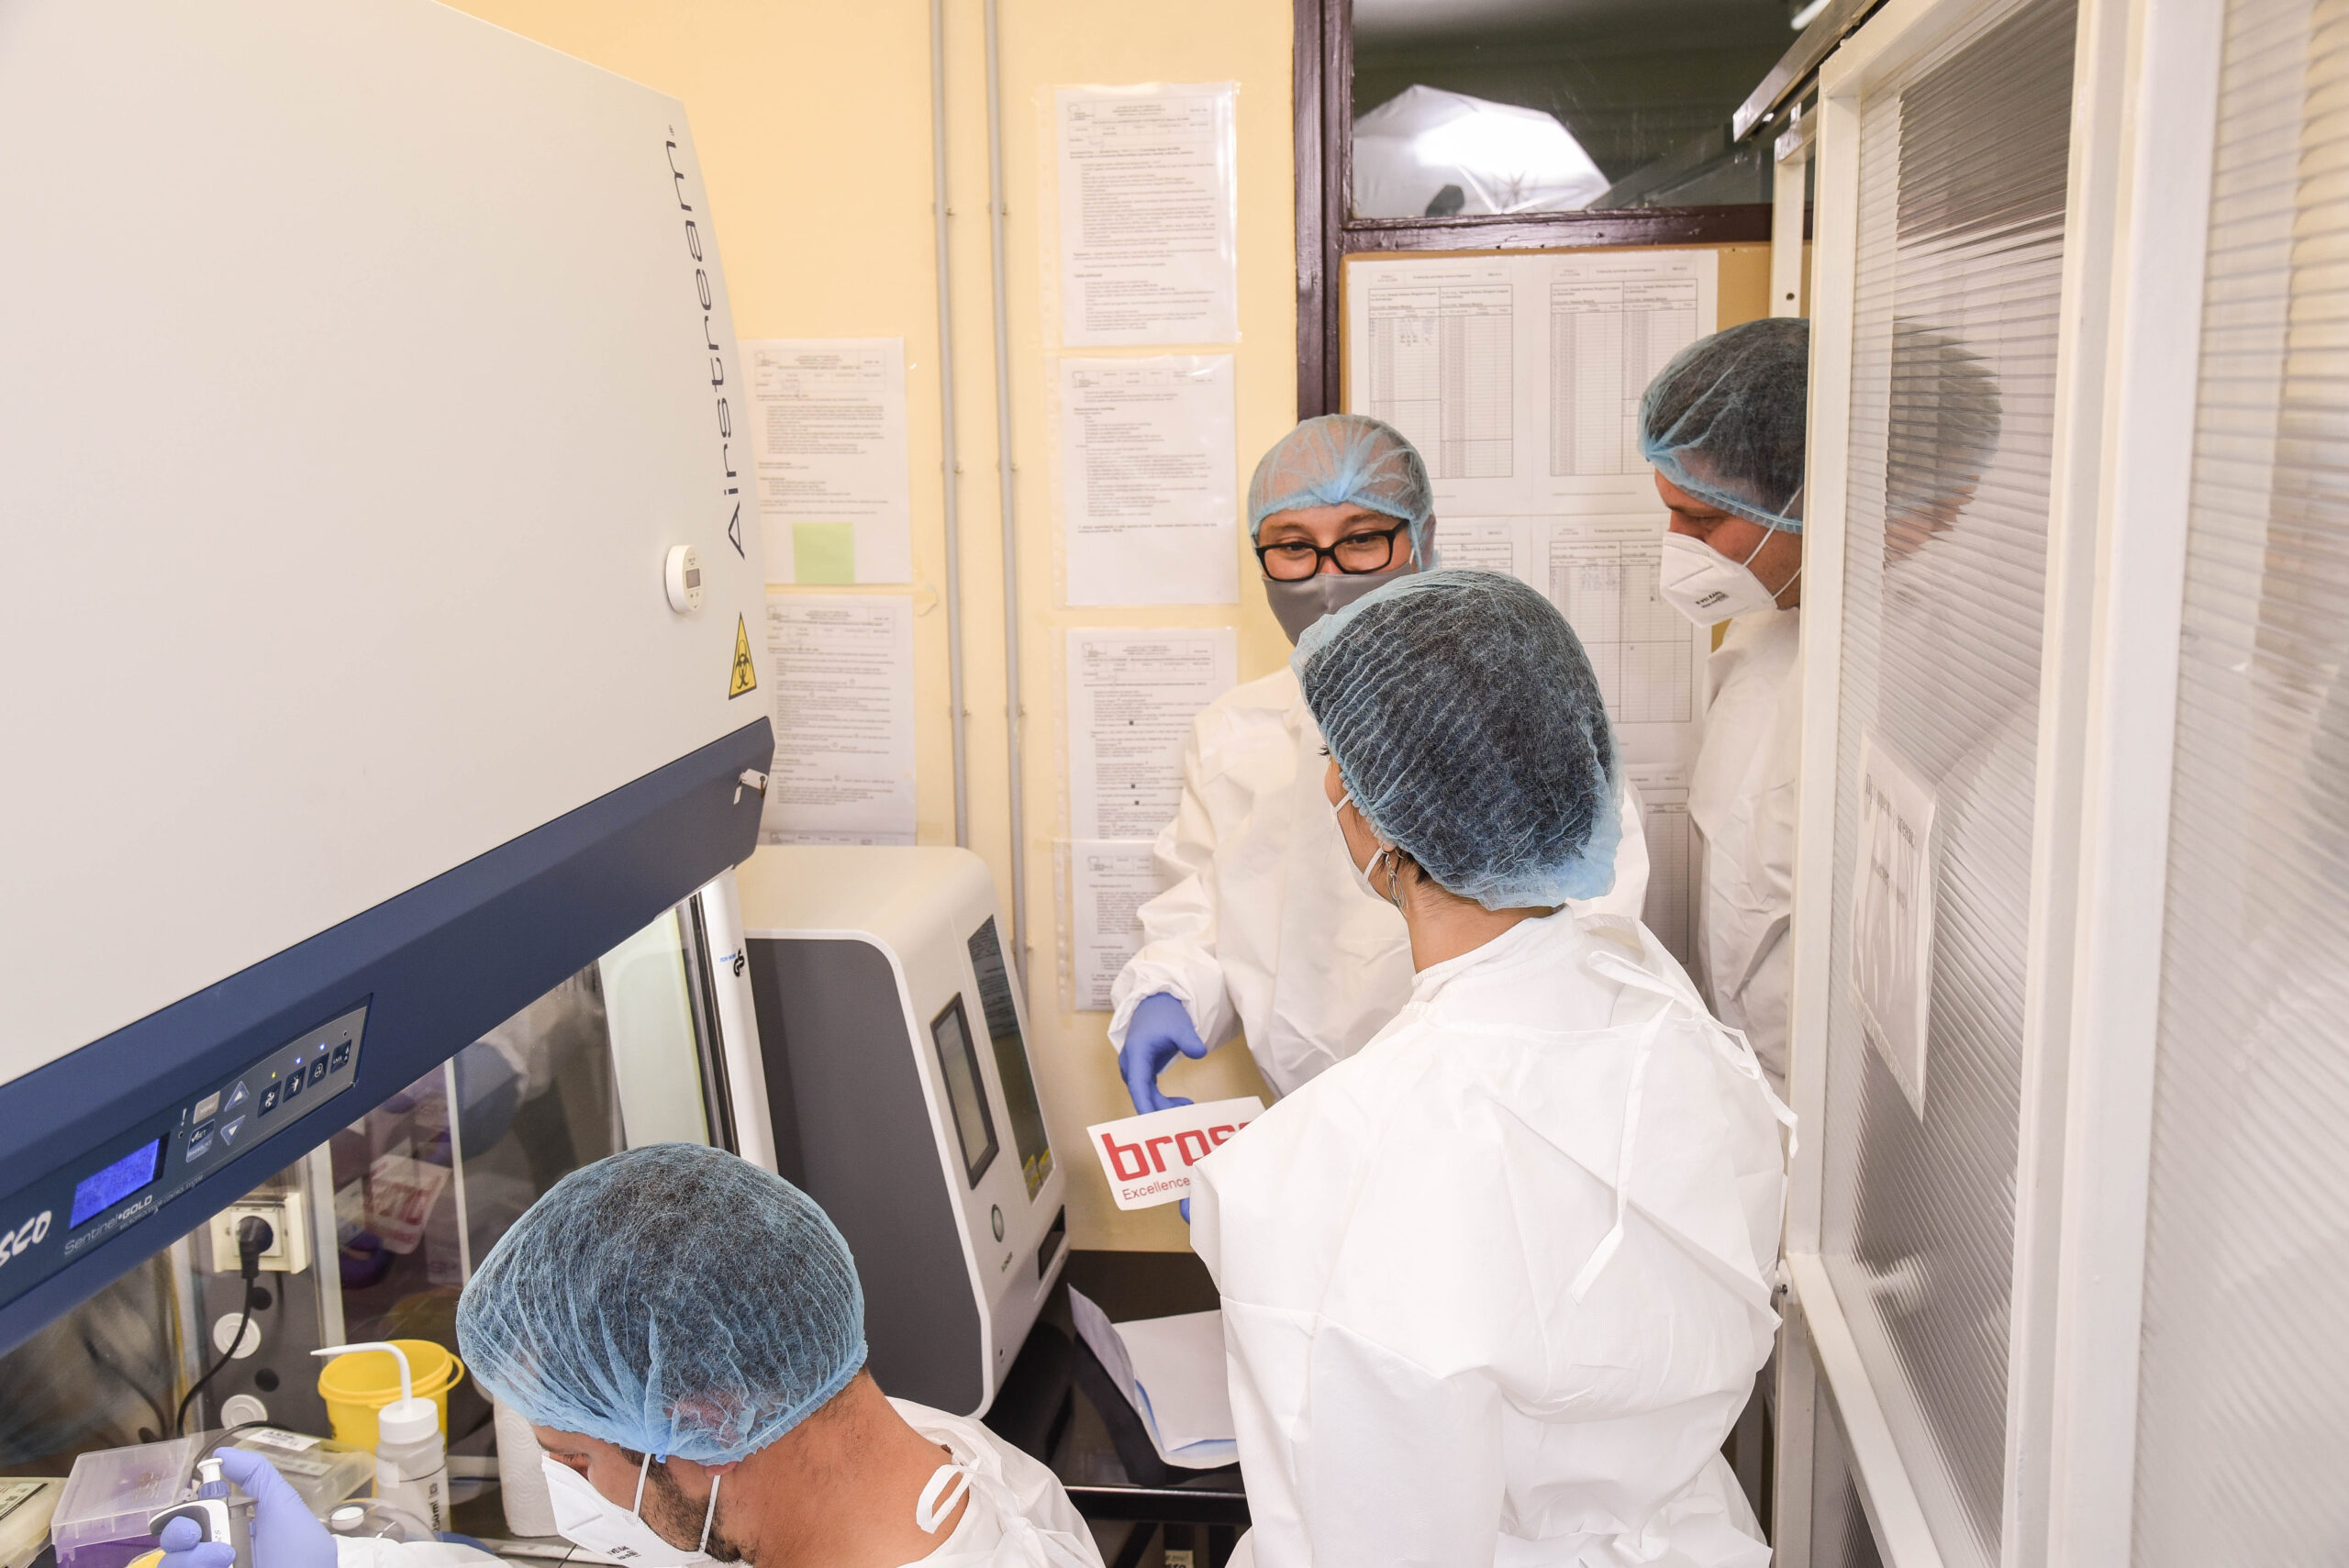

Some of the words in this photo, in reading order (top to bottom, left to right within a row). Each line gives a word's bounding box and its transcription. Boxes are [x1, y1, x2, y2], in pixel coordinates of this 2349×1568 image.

[664, 139, 745, 561] Airstream
[1101, 1121, 1252, 1181] bros
[1122, 1177, 1191, 1200] Excellence
